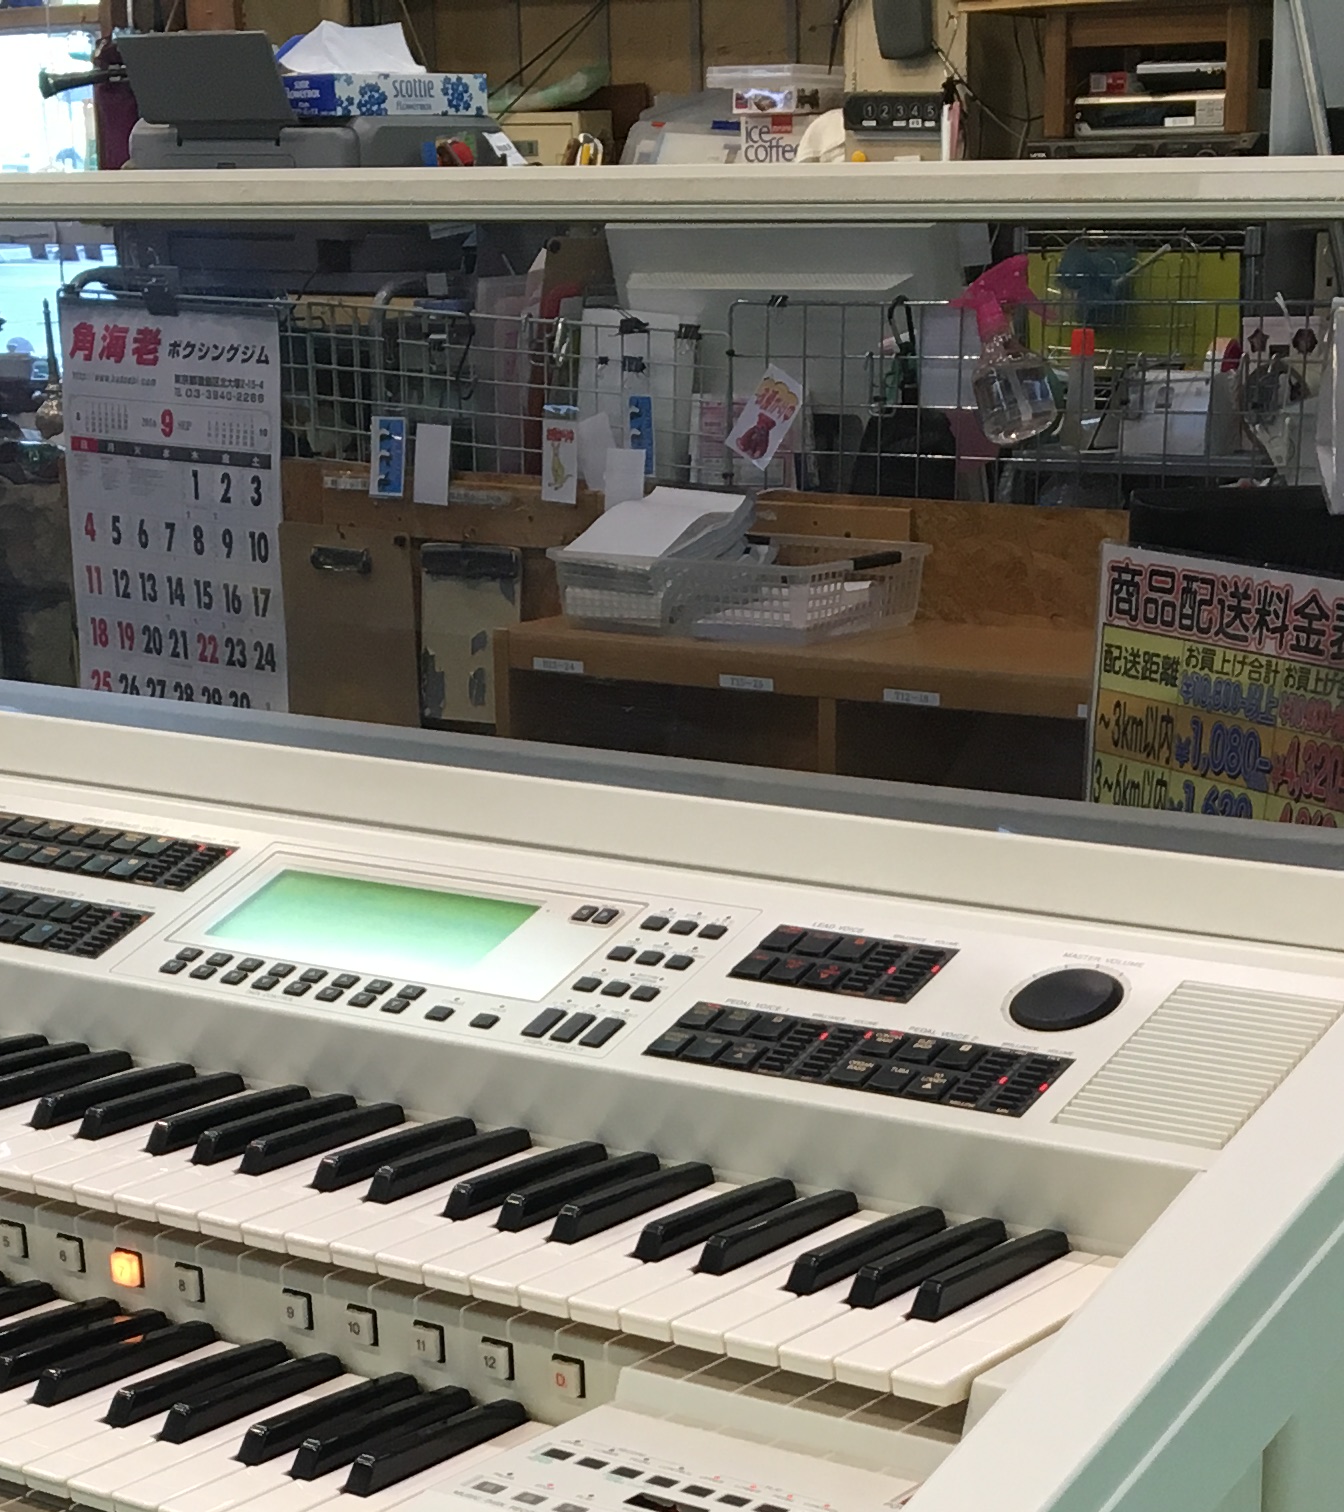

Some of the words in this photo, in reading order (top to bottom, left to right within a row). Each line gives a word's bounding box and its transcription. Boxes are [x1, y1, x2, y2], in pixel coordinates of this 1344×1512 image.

[392, 79, 435, 99] scottie
[745, 124, 770, 142] ice
[744, 138, 798, 163] coffe
[69, 322, 162, 366] 角海老
[167, 340, 270, 365] ボクシングジム
[160, 409, 174, 438] 9
[191, 469, 200, 500] 1
[220, 472, 232, 503] 2
[250, 475, 262, 506] 3
[84, 512, 96, 541] 4
[111, 515, 122, 545] 5
[138, 519, 149, 549] 6
[164, 522, 176, 552] 7
[193, 525, 205, 555] 8
[222, 528, 233, 558] 9
[249, 531, 269, 563] 10
[86, 565, 103, 595] 11
[112, 568, 131, 599] 12
[139, 572, 158, 602] 13
[166, 575, 186, 607] 14
[194, 578, 213, 610] 15
[223, 583, 242, 614] 16
[252, 586, 272, 617] 17
[90, 617, 109, 647] 18
[117, 620, 135, 651] 19
[141, 624, 163, 656] 20
[169, 628, 189, 660] 21
[196, 632, 219, 664] 22
[224, 636, 247, 668] 23
[253, 640, 276, 673] 24
[1103, 642, 1180, 688] 配送距離
[1185, 647, 1280, 686] お買上げ合計
[812, 922, 836, 933] LEAD
[1063, 951, 1099, 962] MASTER
[725, 998, 753, 1009] PEDAL
[908, 1026, 937, 1036] PEDAL
[890, 1066, 911, 1075] TUBA
